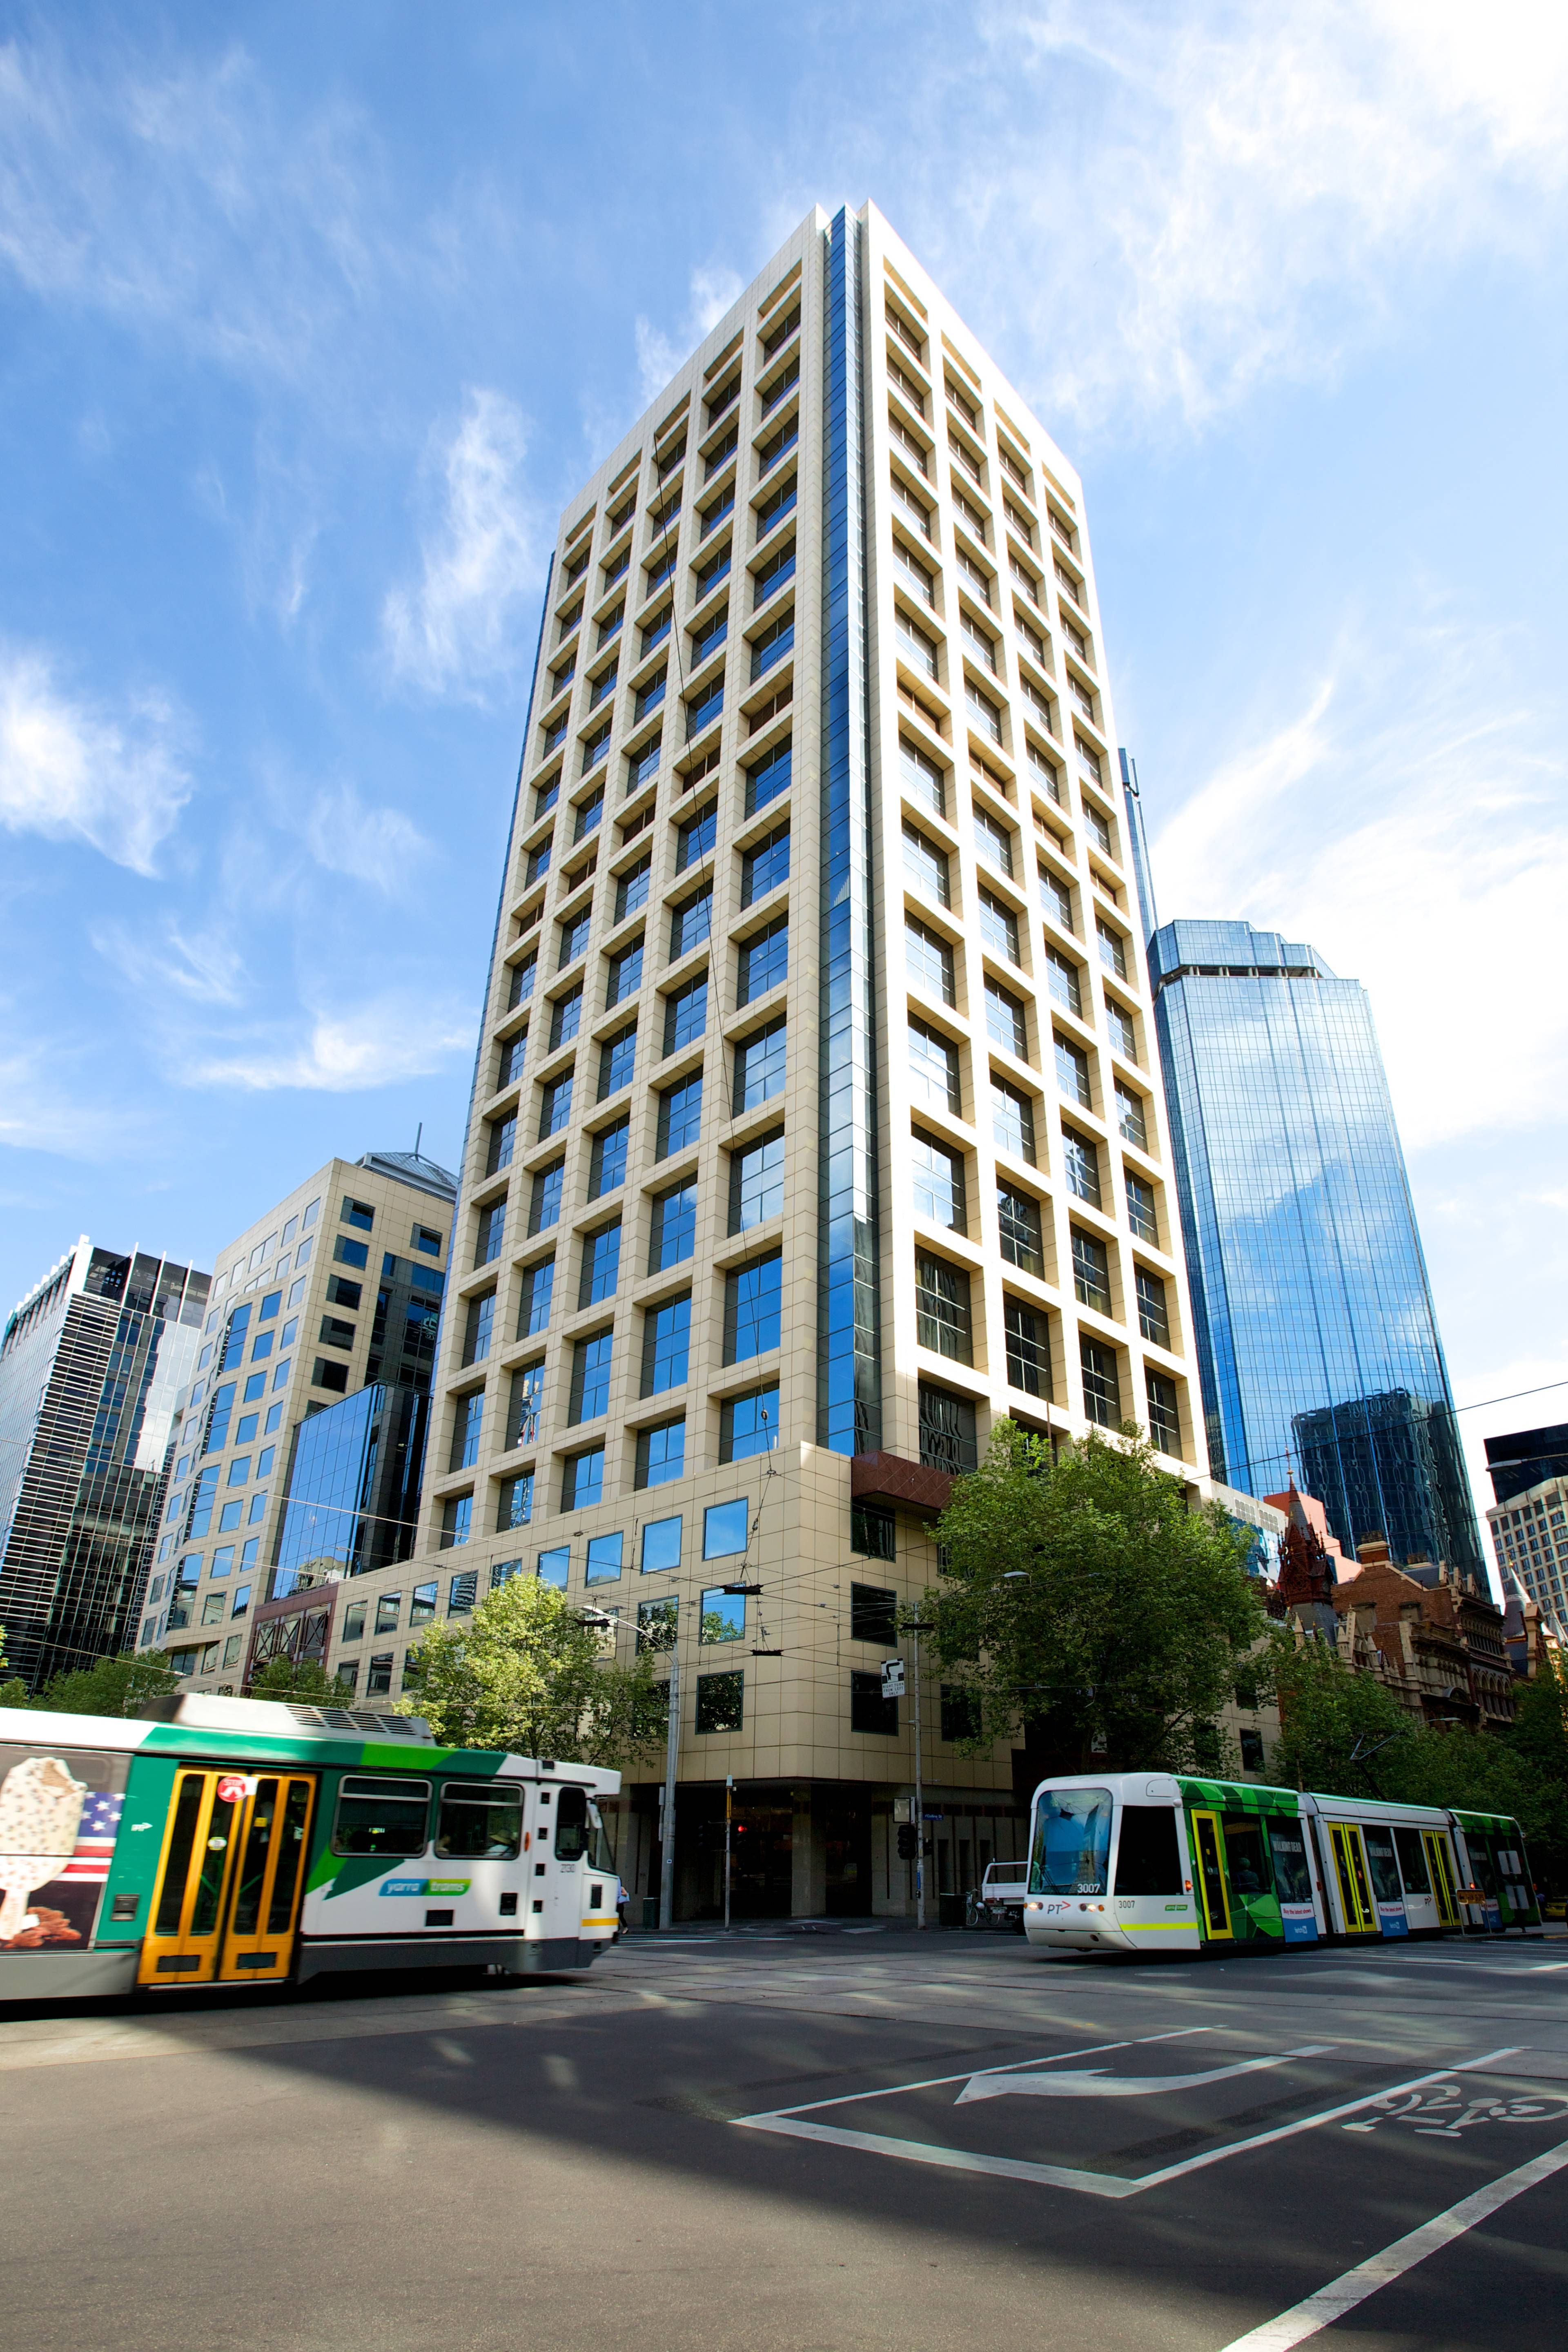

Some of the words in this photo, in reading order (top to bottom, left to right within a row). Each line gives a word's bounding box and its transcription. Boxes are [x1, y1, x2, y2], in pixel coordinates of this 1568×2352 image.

[386, 1883, 420, 1894] yarra
[431, 1882, 466, 1891] trams
[1077, 1883, 1100, 1893] 3007
[1118, 1900, 1135, 1908] 3007
